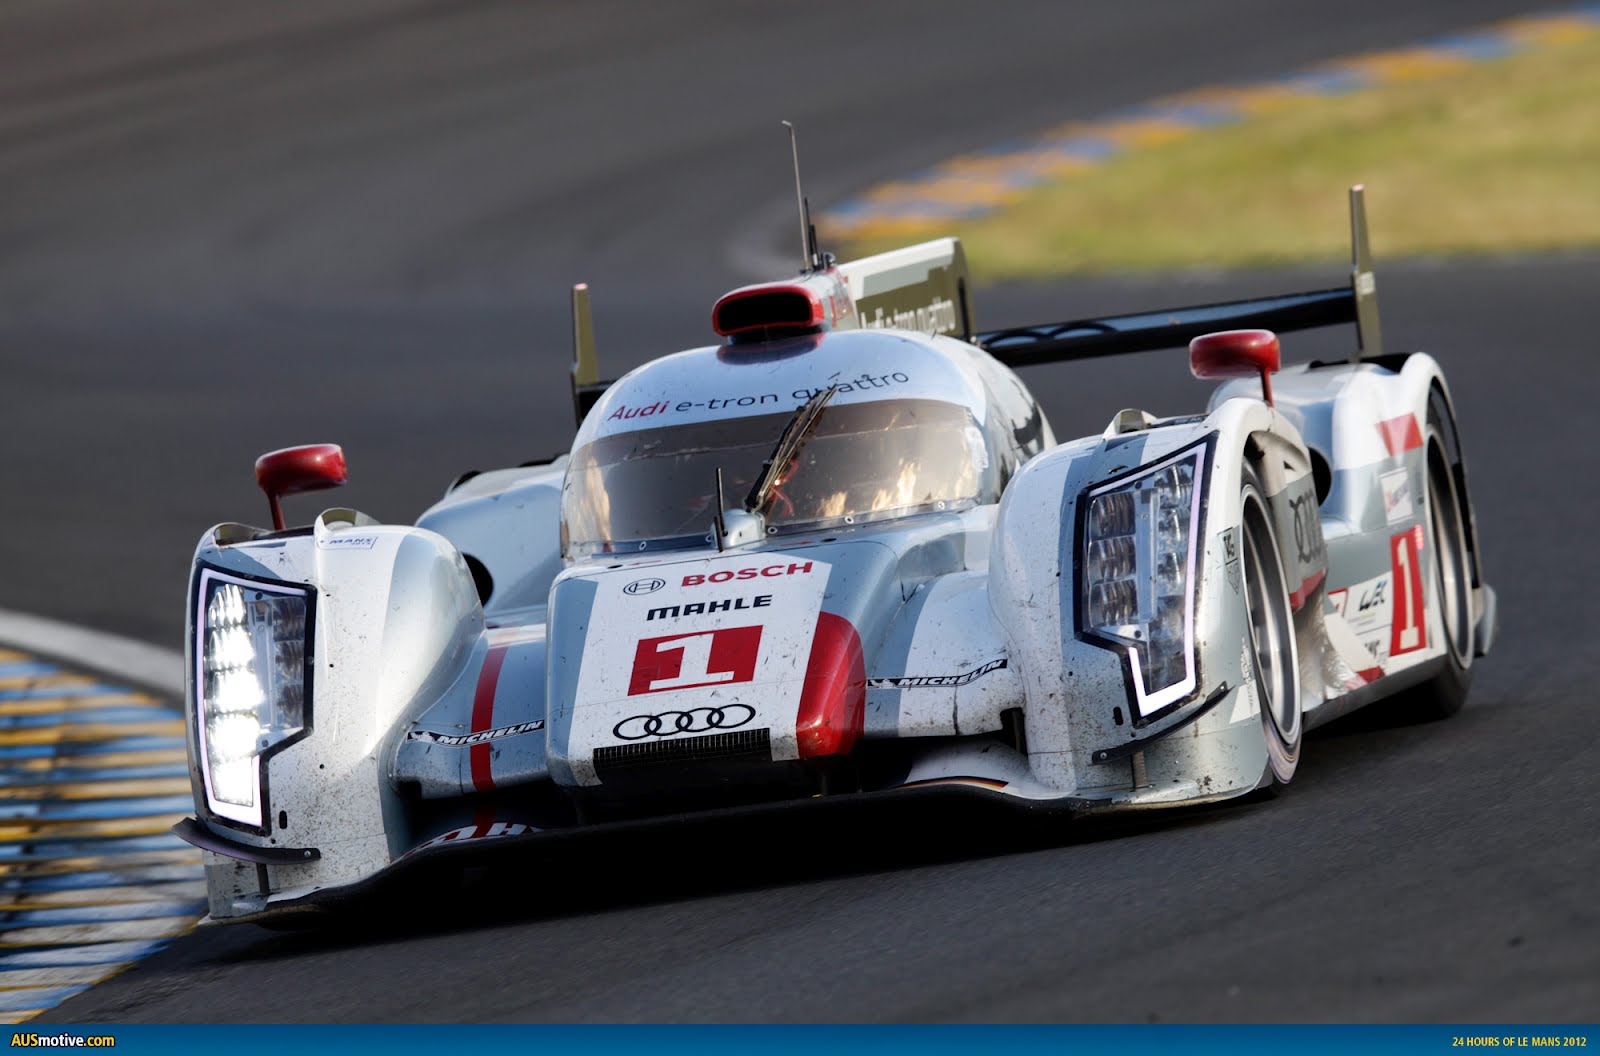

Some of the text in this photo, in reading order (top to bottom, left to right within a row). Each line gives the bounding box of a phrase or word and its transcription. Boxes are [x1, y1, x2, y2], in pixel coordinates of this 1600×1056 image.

[608, 372, 909, 421] Audi e-tron quattro
[681, 562, 813, 587] BOSCH
[1397, 537, 1419, 650] 1
[647, 595, 773, 621] MAHLE
[649, 633, 735, 691] 1
[898, 659, 1004, 686] MICHELIN
[436, 720, 543, 745] MICHELIN
